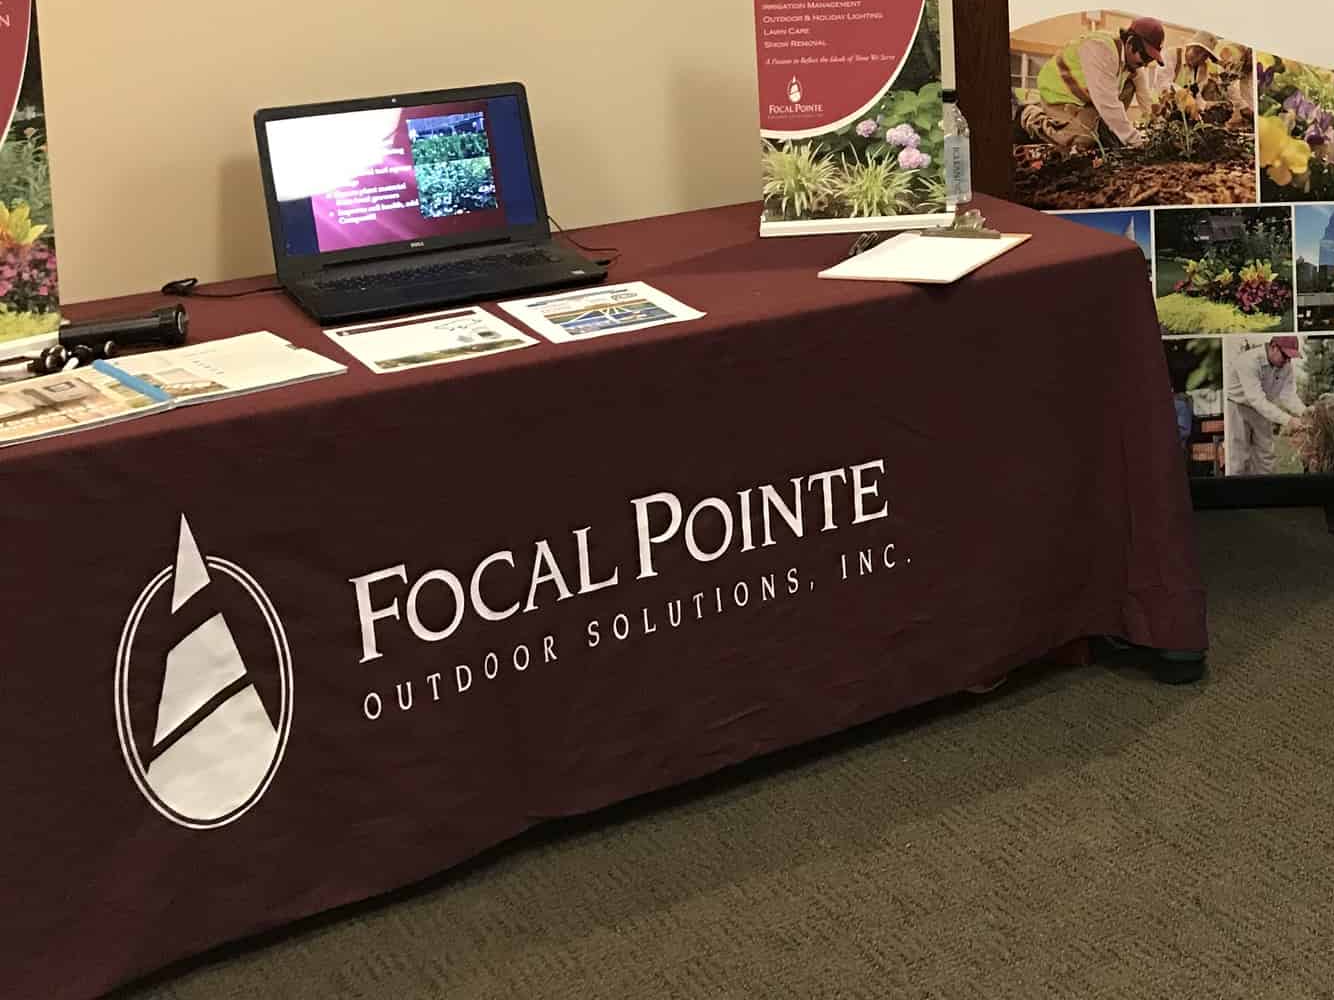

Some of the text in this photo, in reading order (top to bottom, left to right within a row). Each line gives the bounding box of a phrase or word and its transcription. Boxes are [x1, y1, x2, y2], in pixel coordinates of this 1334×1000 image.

[807, 1, 861, 9] MANAGEMENT
[762, 15, 803, 23] OUTDOOR
[768, 103, 824, 114] FOCAL POINTE
[348, 458, 890, 664] FOCAL POINTE
[364, 542, 912, 720] OUTDOOR SOLUTIONS, INC.
